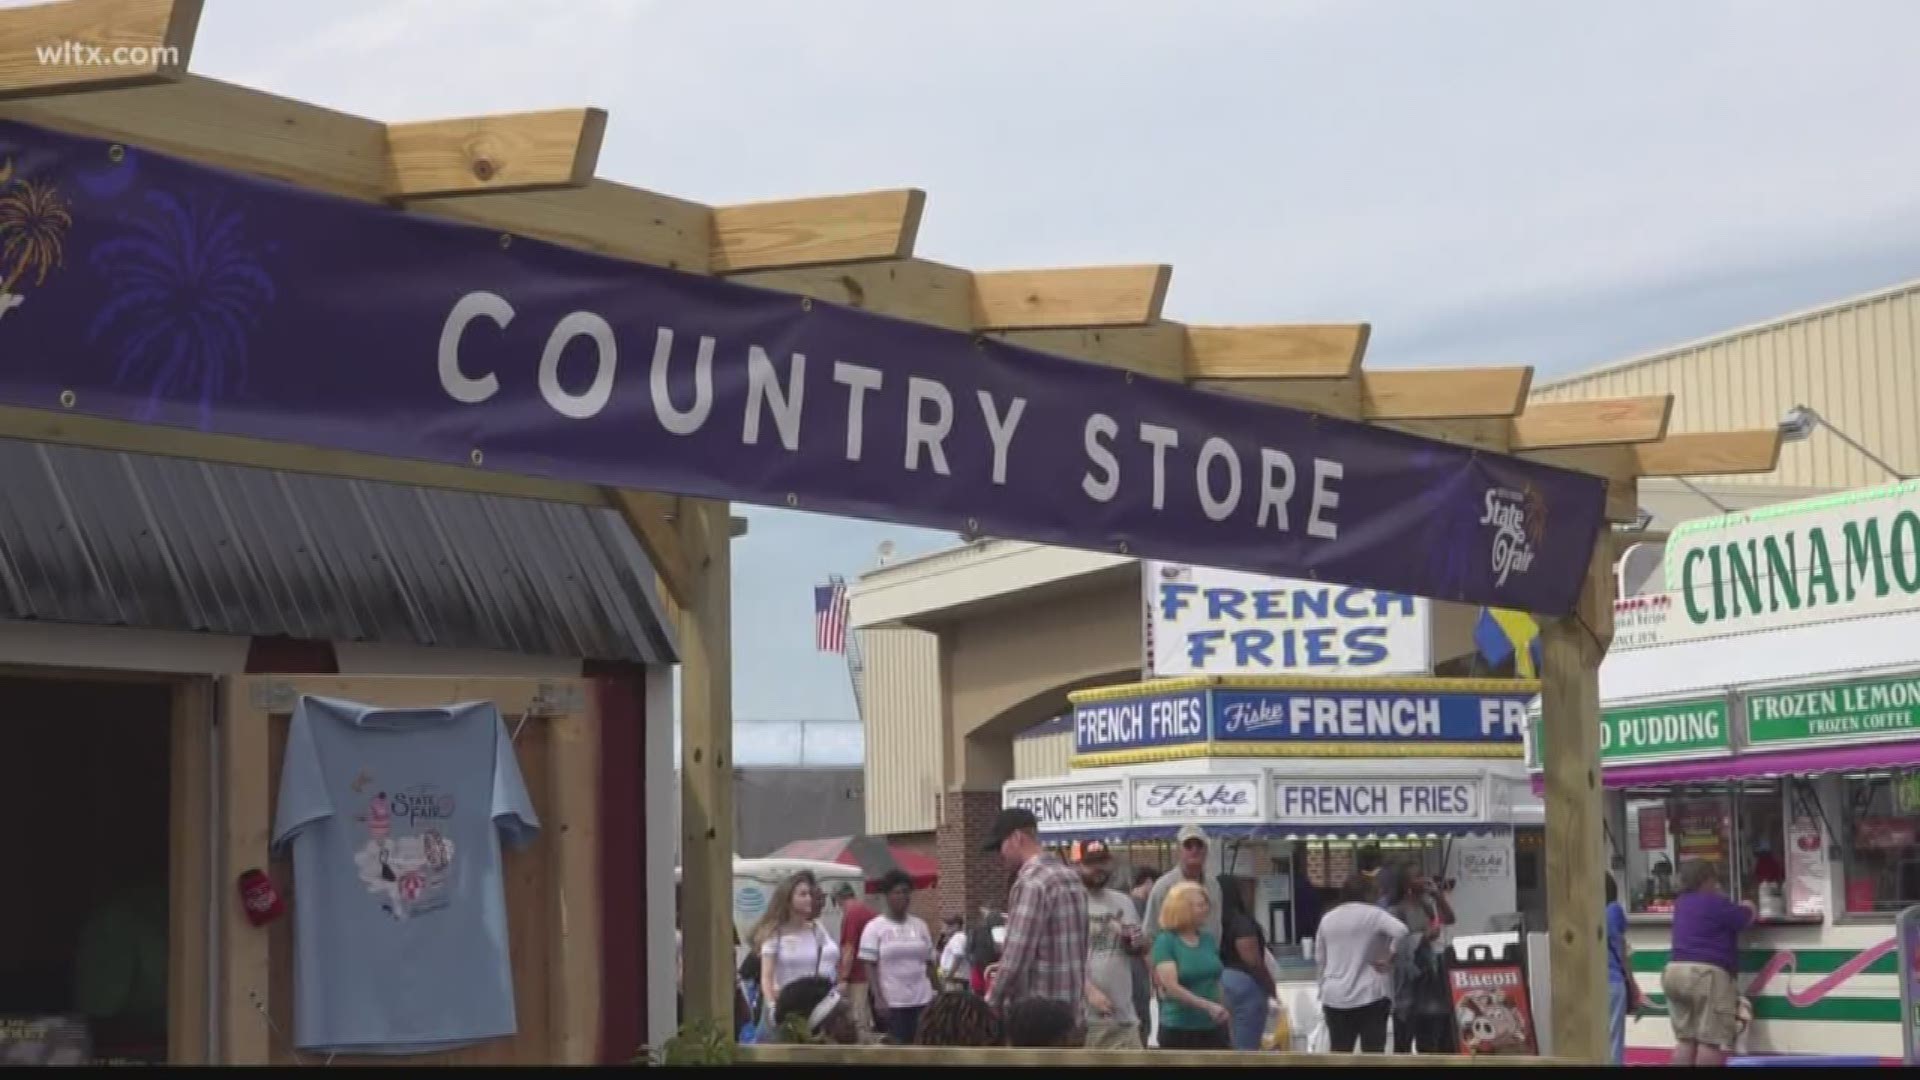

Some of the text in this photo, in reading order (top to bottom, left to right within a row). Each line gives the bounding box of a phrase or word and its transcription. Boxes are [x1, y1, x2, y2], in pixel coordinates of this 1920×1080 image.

[437, 290, 1344, 540] COUNTRY STORE
[1480, 488, 1525, 530] State
[1682, 509, 1920, 625] CINNAMO
[1160, 583, 1415, 621] FRENCH
[1186, 626, 1389, 668] FRIES
[1224, 698, 1284, 733] Fiske
[1290, 698, 1441, 736] FRENCH
[1752, 681, 1920, 721] FROZEN LEMON
[1077, 697, 1201, 746] FRENCH FRIES
[1618, 709, 1719, 748] PUDDING
[1809, 711, 1913, 735] FROZEN COFFEE
[1076, 791, 1119, 818] FRIES
[1147, 784, 1249, 808] Fiske
[1285, 785, 1470, 814] FRENCH FRIES
[1454, 971, 1518, 988] Bacon
